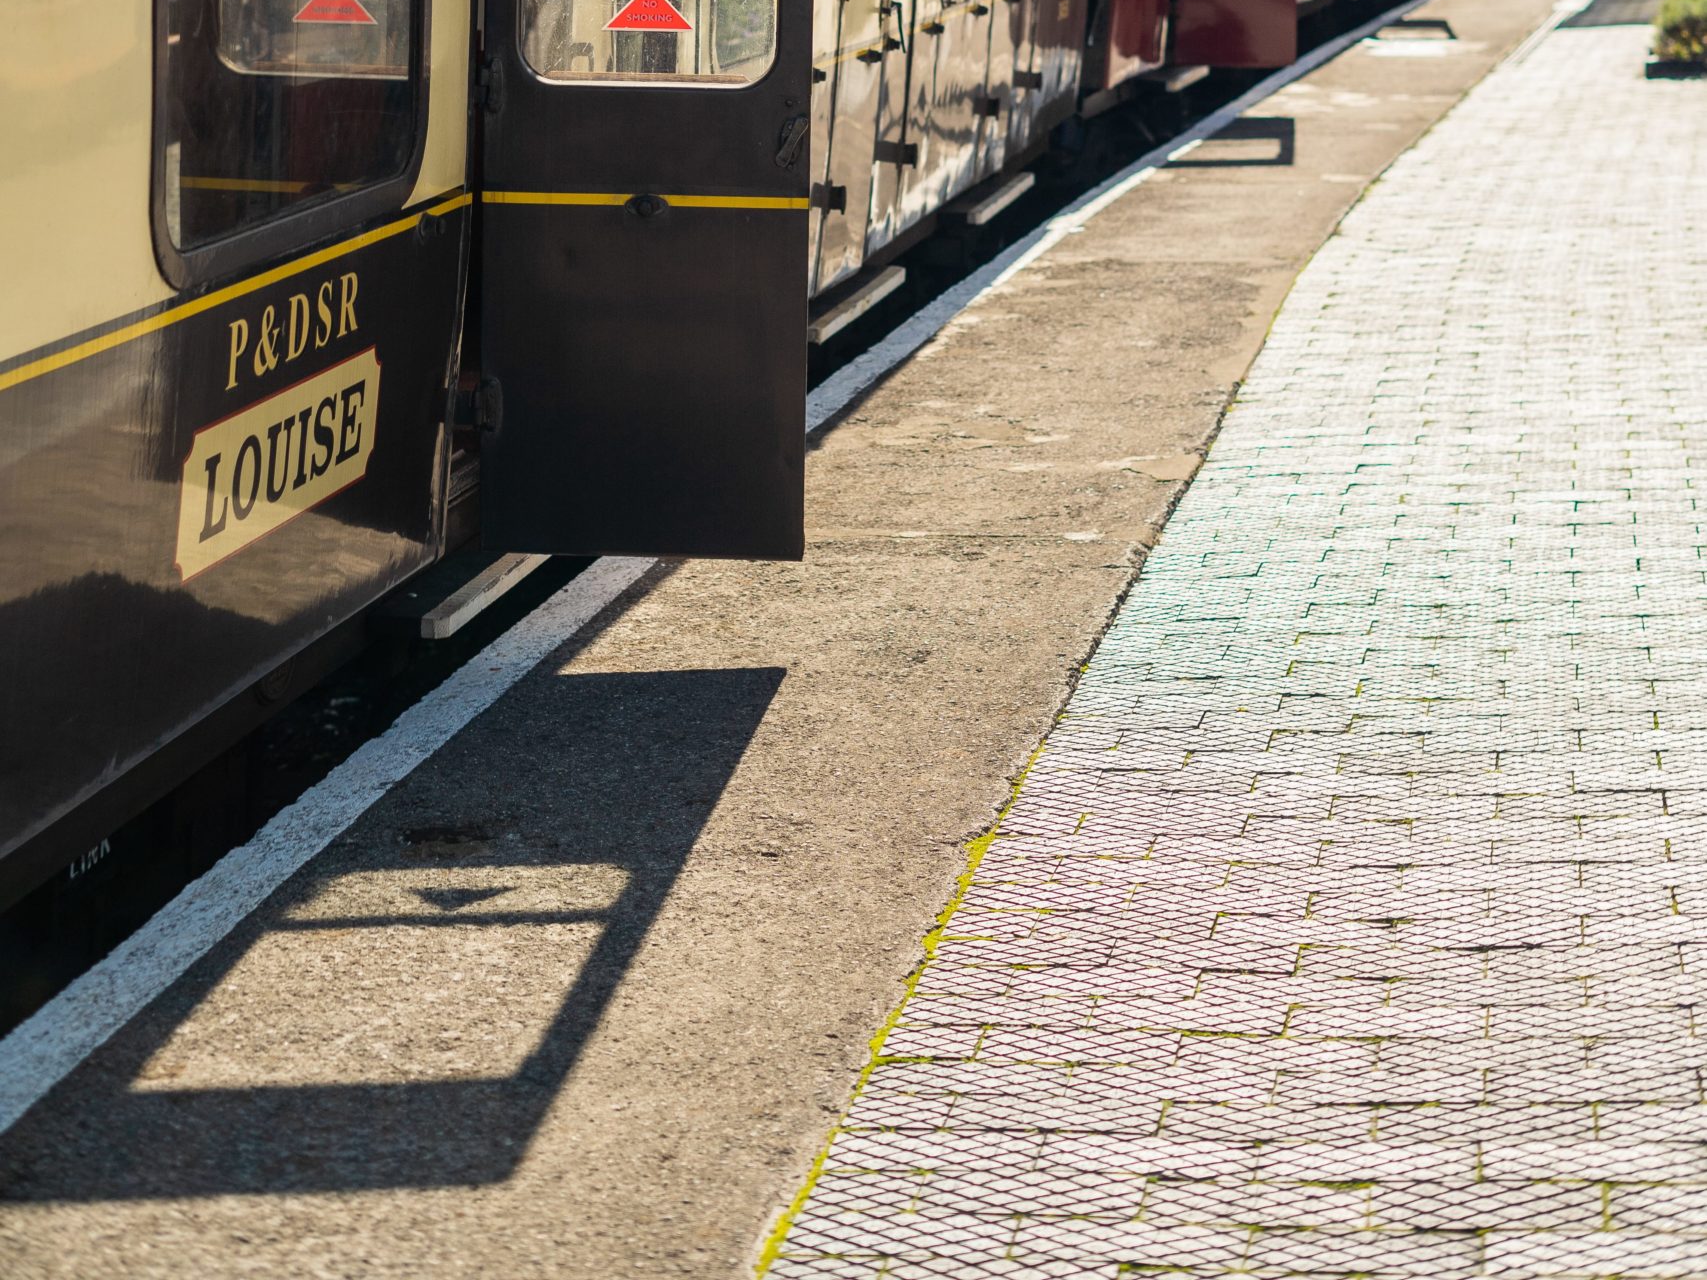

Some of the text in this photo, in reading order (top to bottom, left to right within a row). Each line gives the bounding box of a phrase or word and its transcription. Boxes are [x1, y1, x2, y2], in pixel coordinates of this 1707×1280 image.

[626, 13, 673, 22] SMOKING
[642, 0, 658, 8] NO
[225, 271, 359, 392] P&DSR
[199, 378, 366, 544] LOUISE
